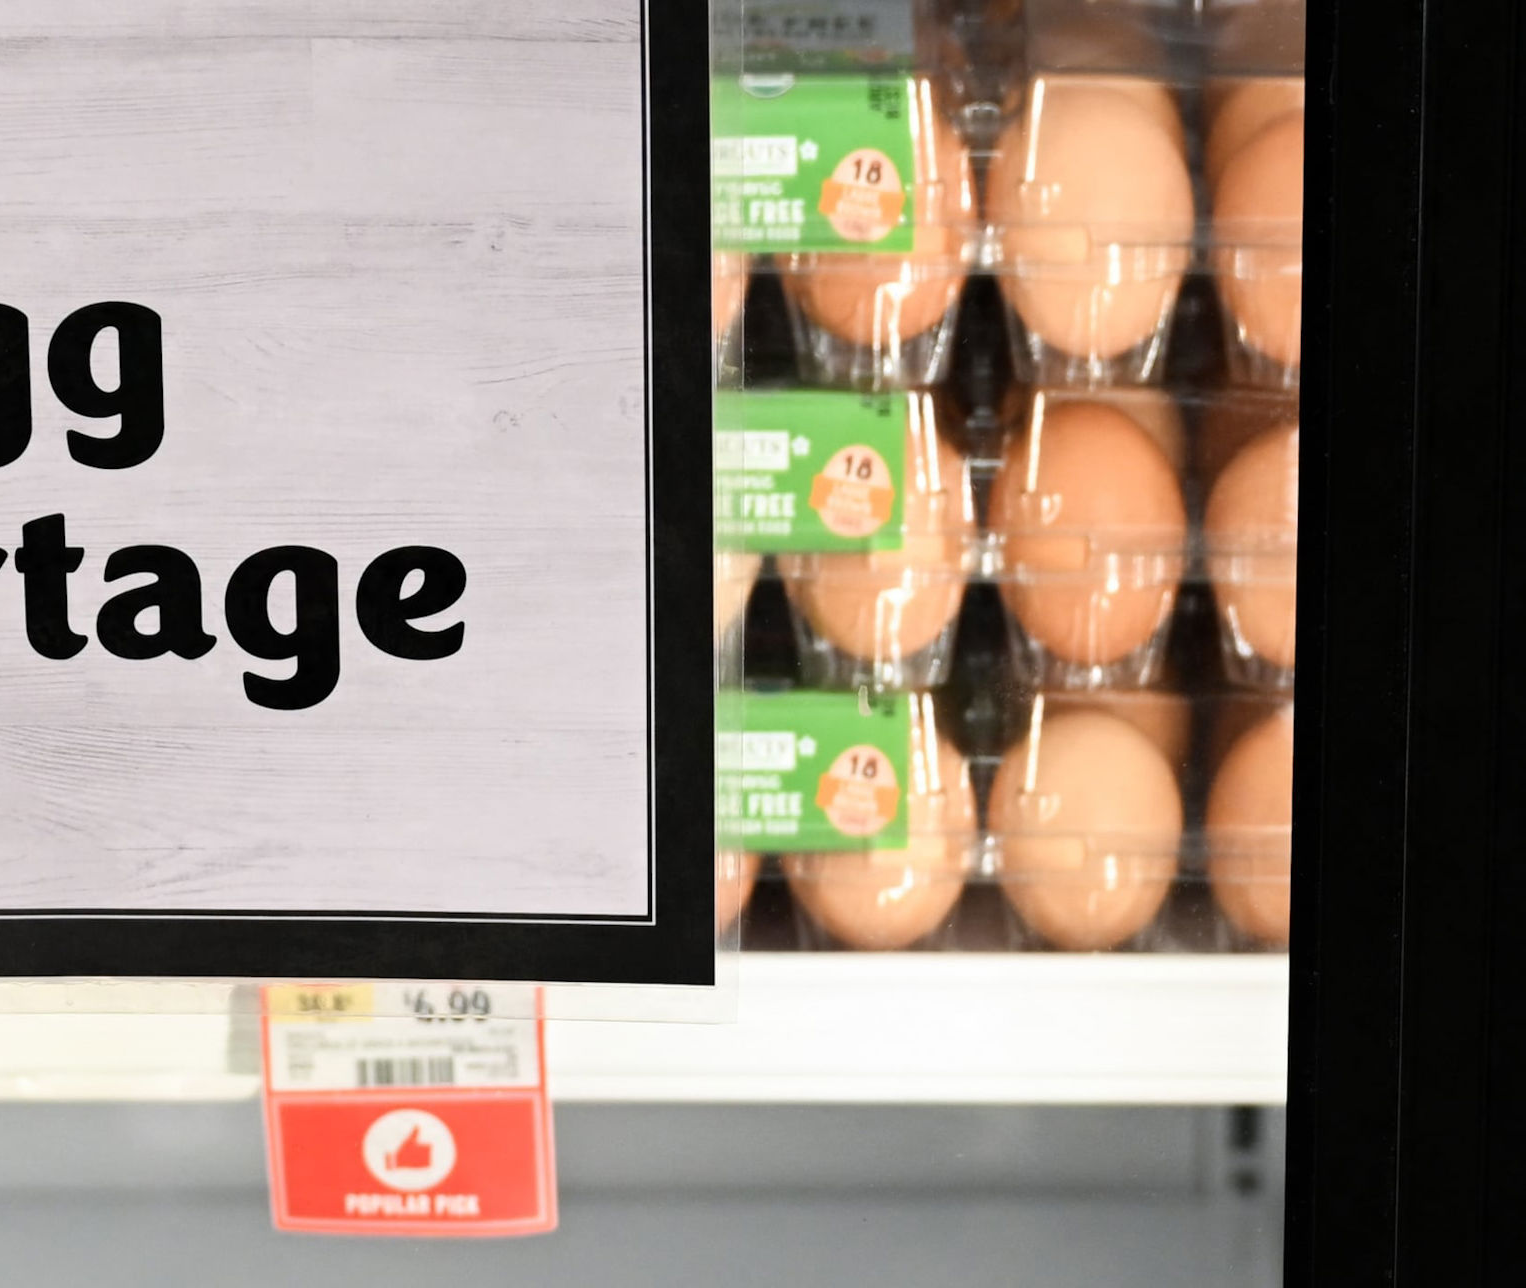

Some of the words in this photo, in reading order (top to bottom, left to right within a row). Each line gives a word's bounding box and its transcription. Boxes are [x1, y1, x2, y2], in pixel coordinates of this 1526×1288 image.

[853, 158, 882, 185] 18
[749, 200, 805, 224] FREE
[843, 454, 873, 480] 18
[345, 1193, 429, 1215] POPULAR
[434, 1193, 481, 1215] PICK
